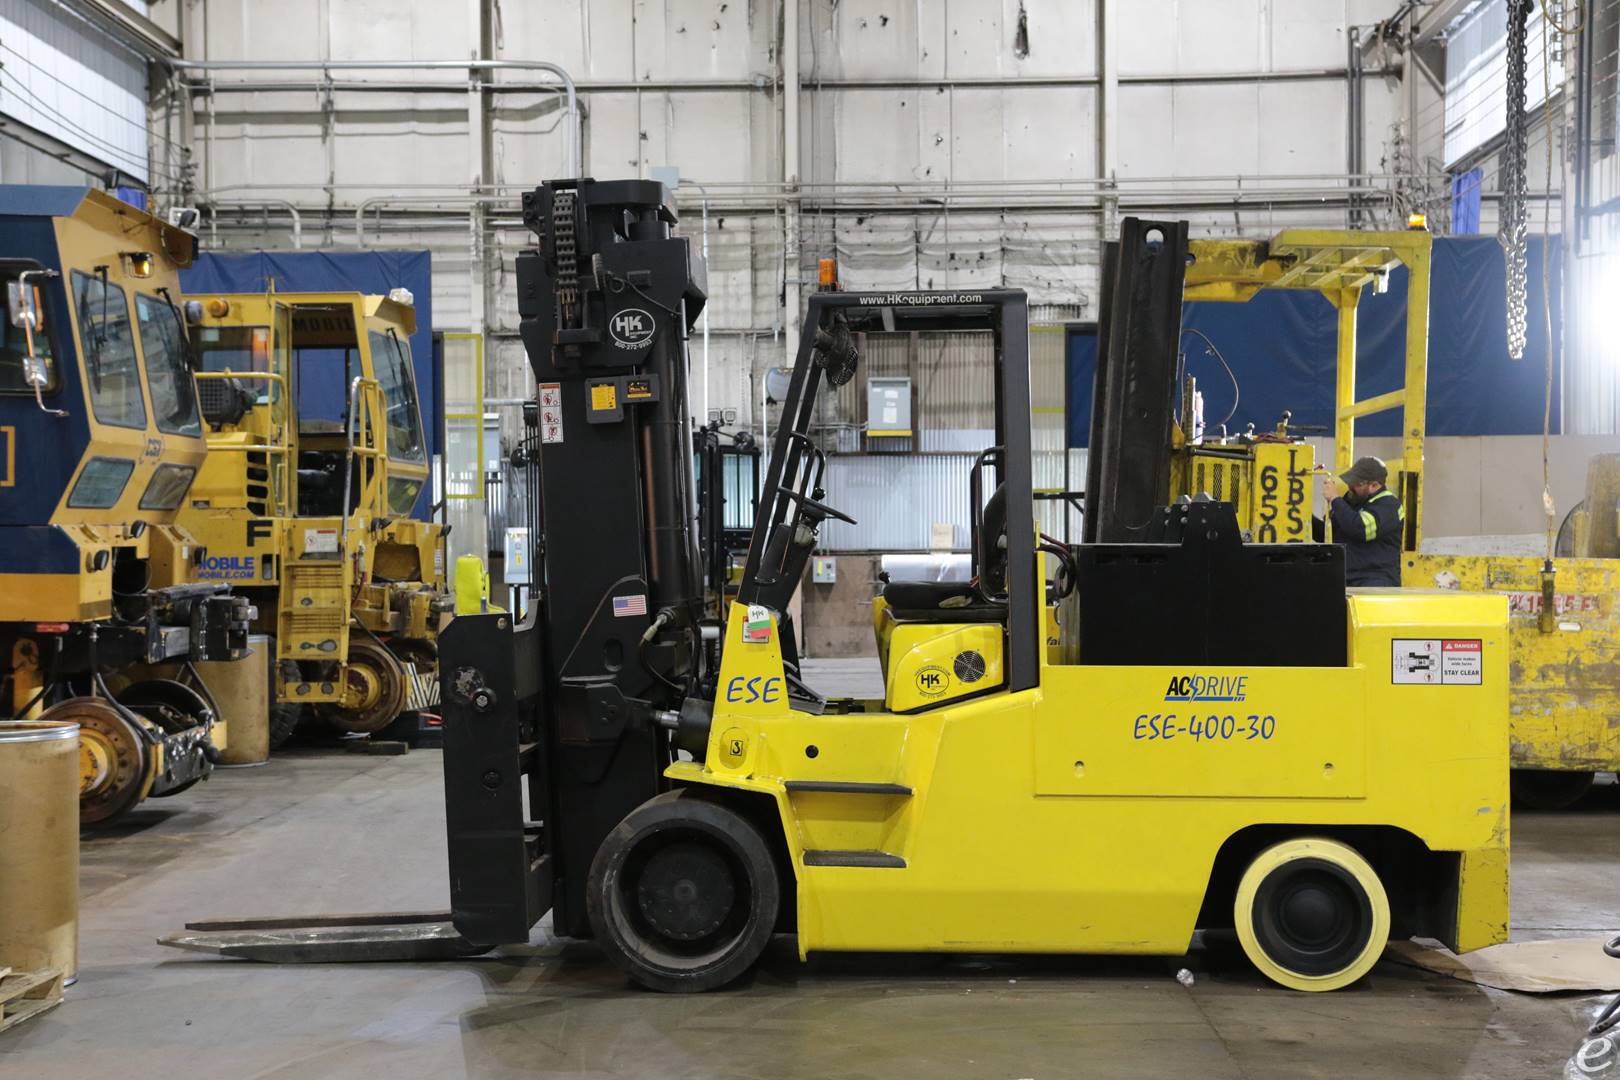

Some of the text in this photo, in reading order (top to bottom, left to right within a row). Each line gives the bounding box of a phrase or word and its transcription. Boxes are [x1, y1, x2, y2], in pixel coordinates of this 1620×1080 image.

[615, 315, 642, 336] HK
[1286, 449, 1304, 543] LBS
[247, 520, 273, 547] F
[727, 676, 781, 703] ESE
[921, 674, 940, 688] HK
[1134, 714, 1276, 742] ESE-400-30
